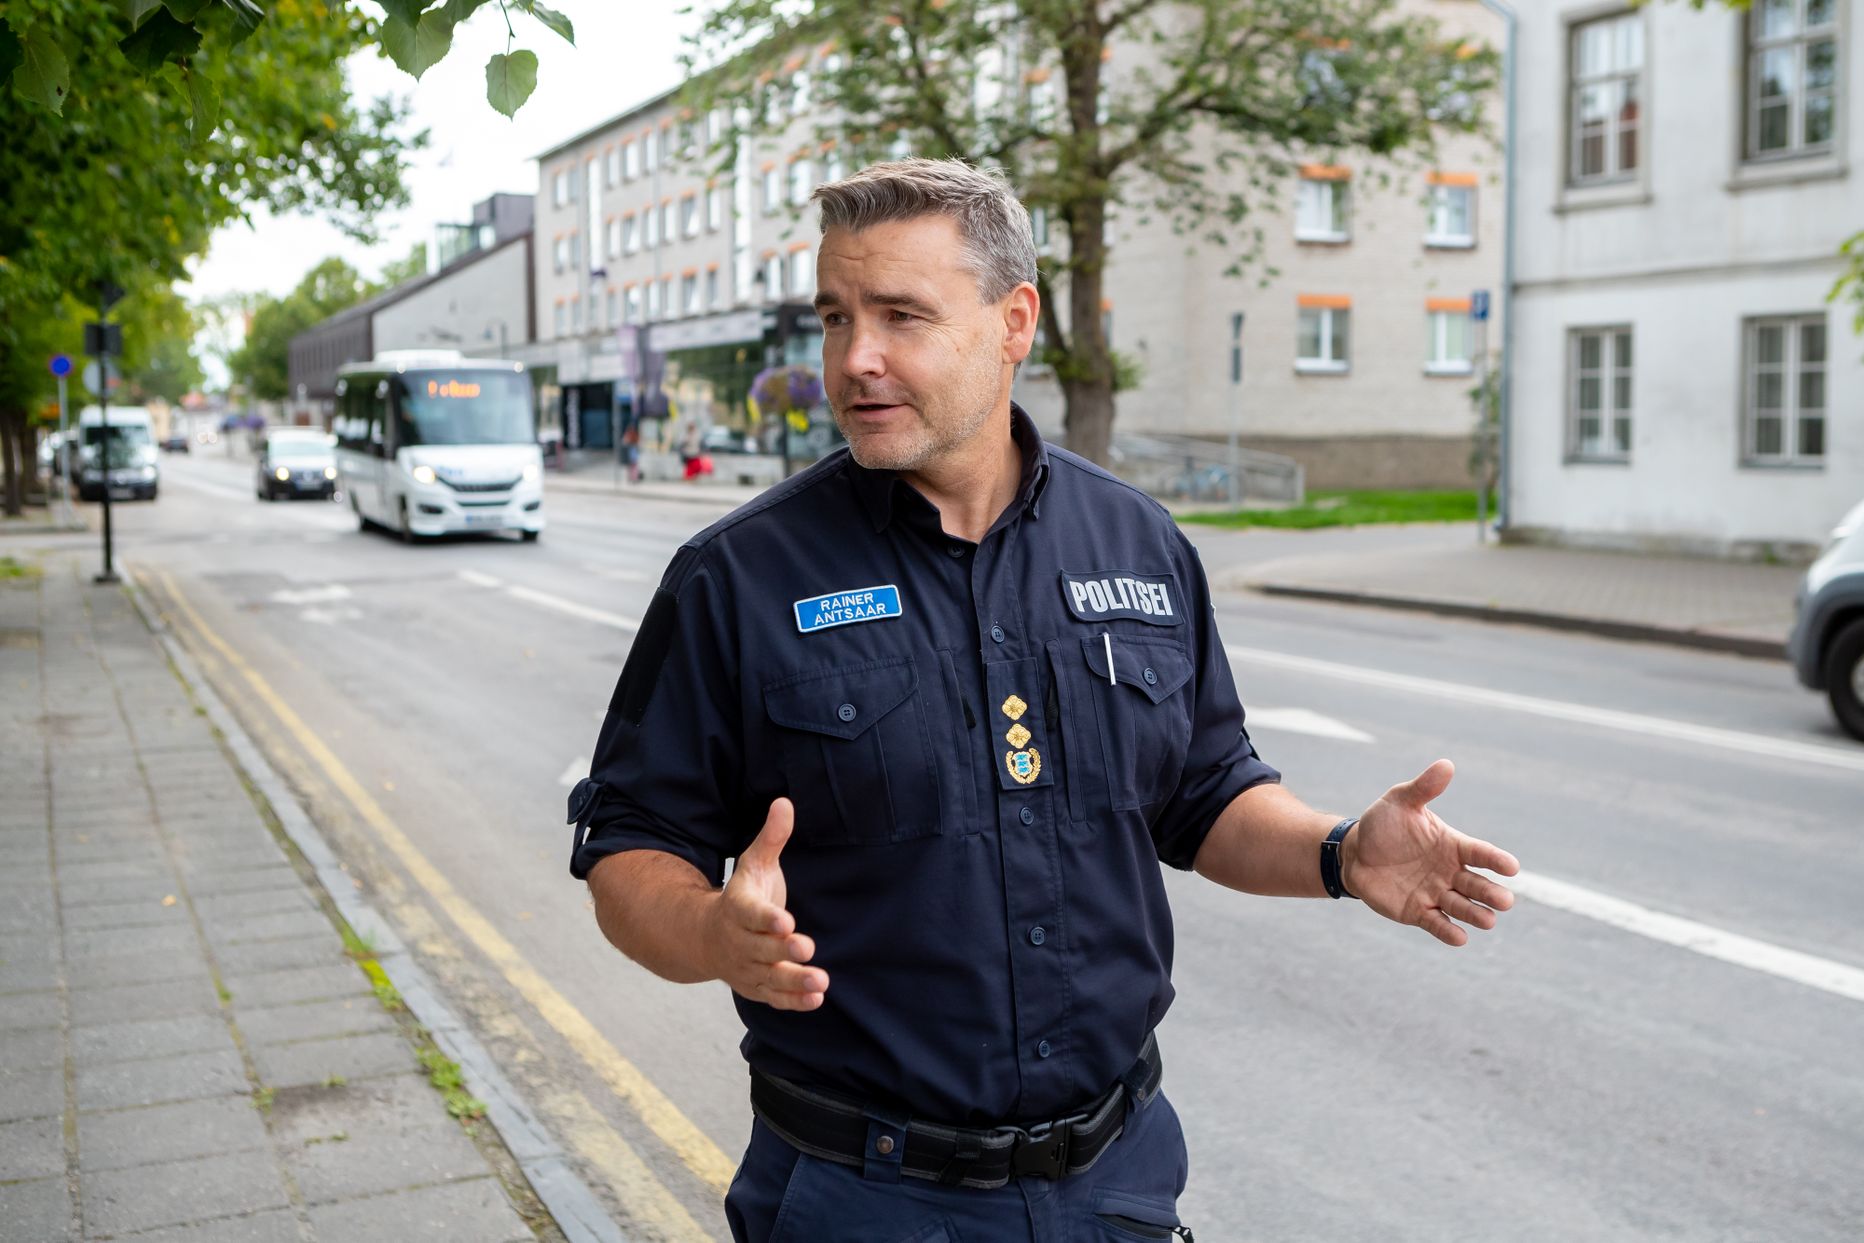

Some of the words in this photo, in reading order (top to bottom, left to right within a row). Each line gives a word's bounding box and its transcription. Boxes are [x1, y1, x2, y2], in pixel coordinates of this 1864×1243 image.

[820, 592, 874, 611] RAINER
[1069, 578, 1174, 616] POLITSEI
[814, 603, 887, 626] ANTSAAR
